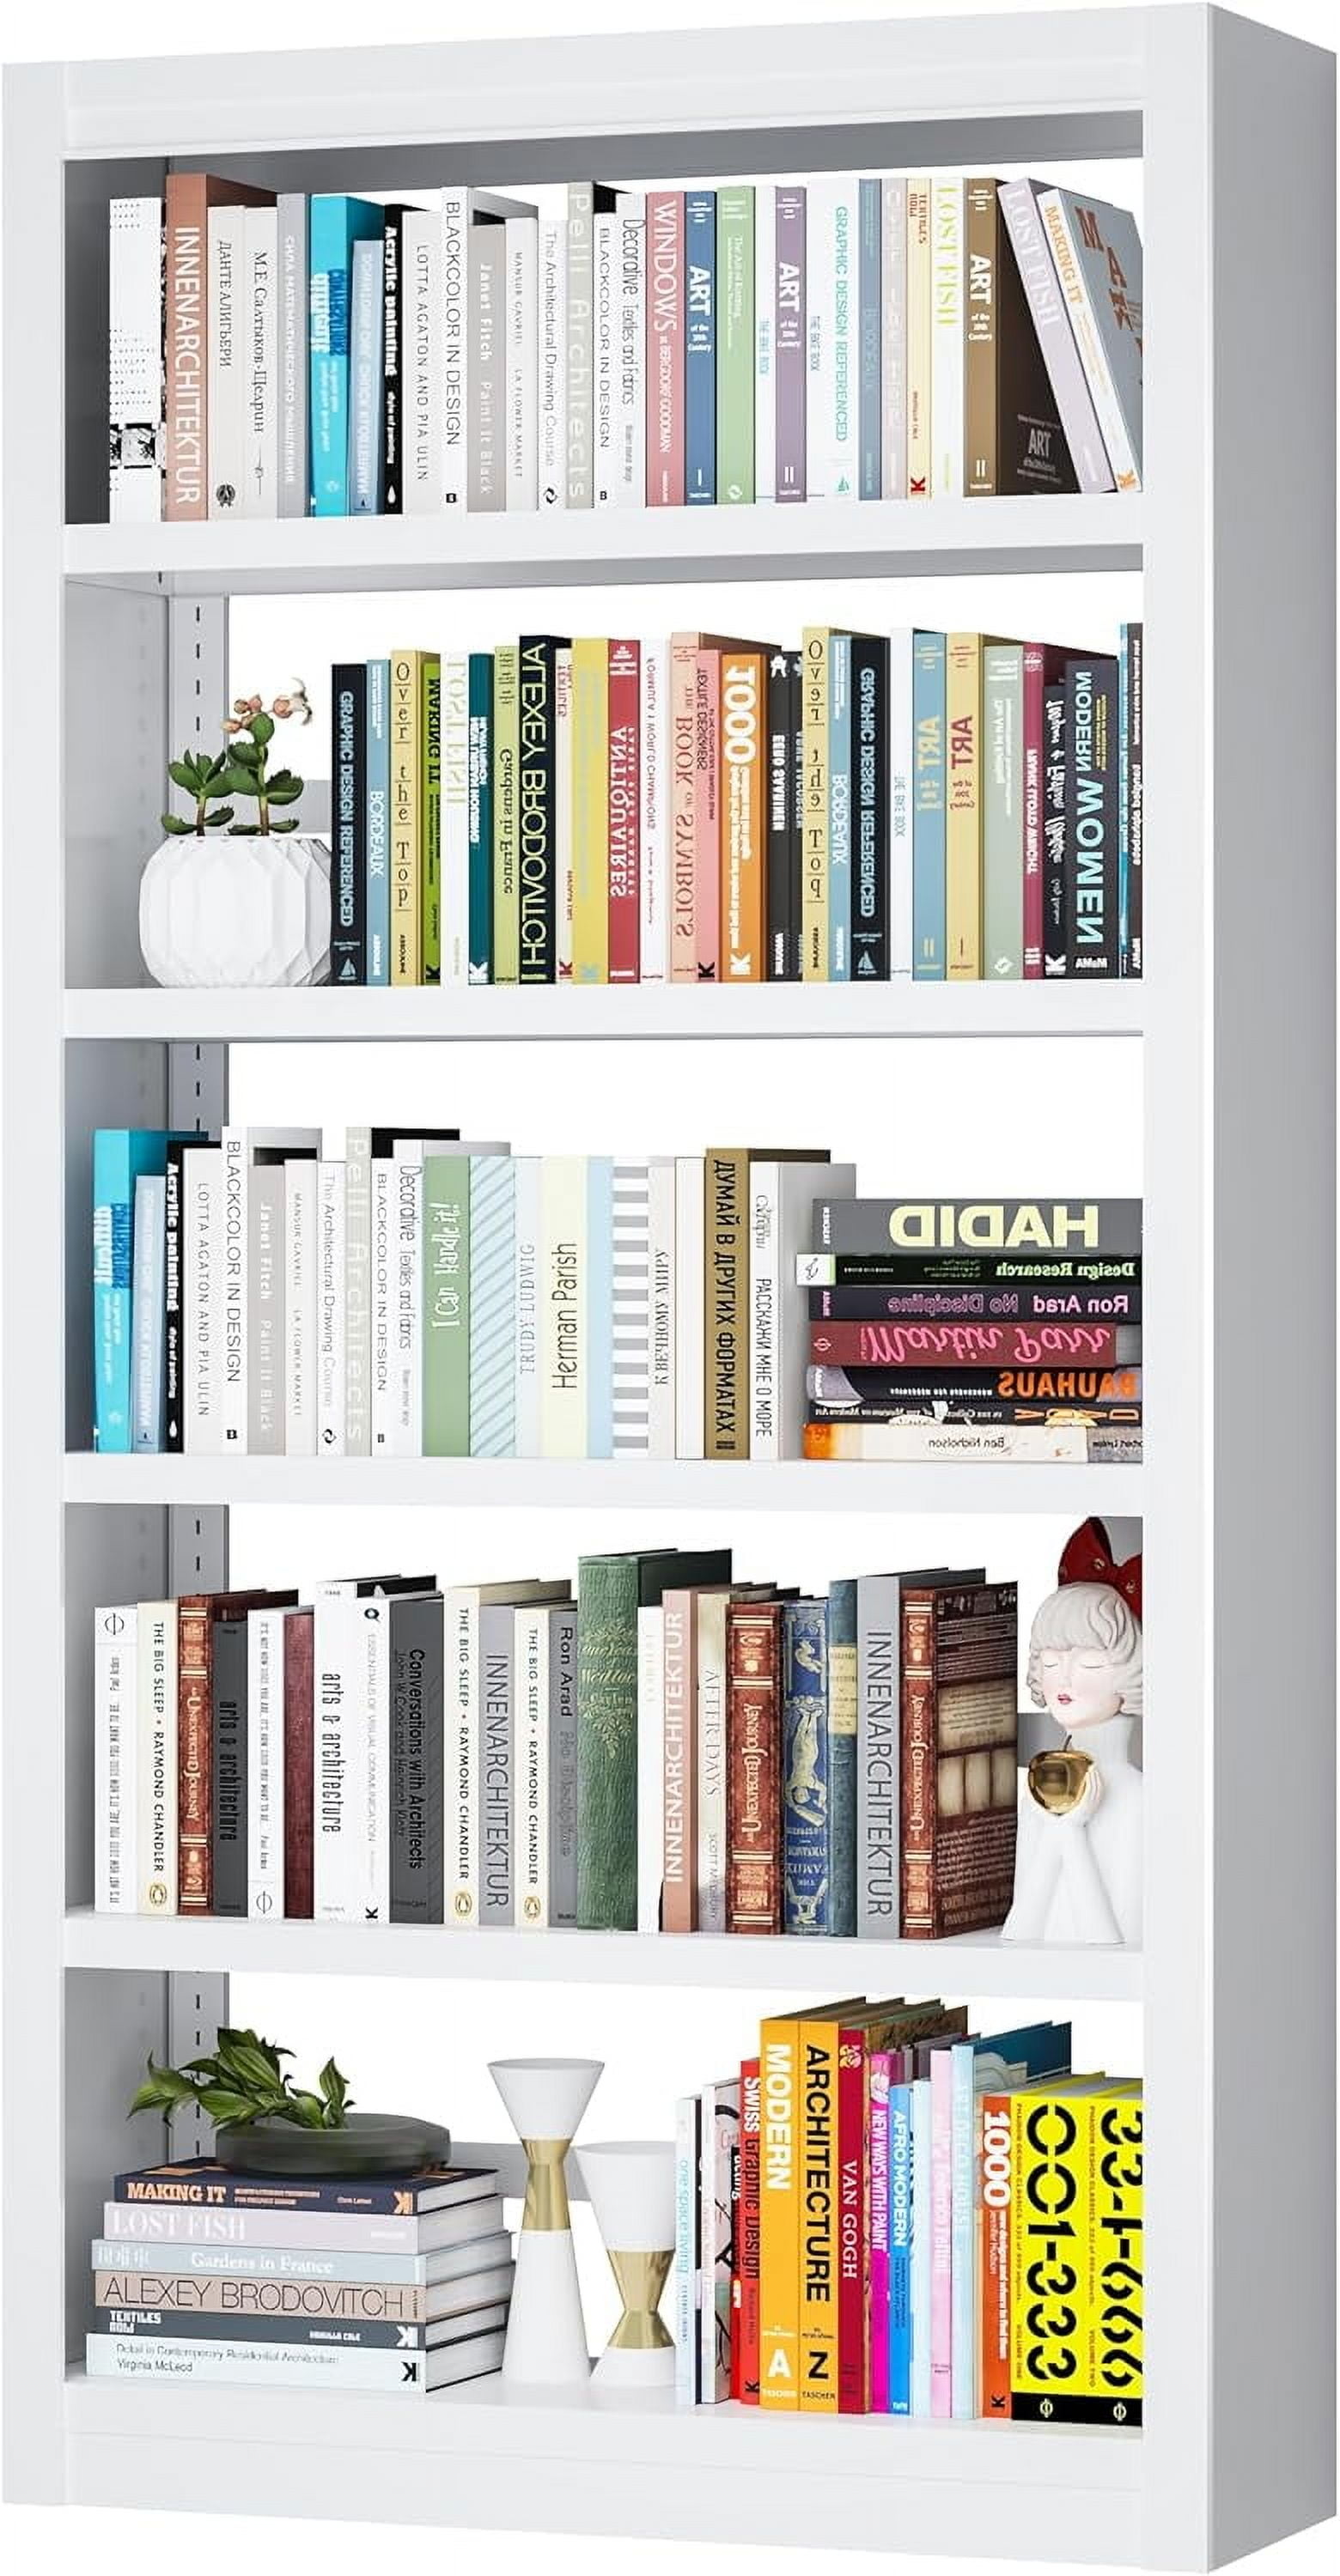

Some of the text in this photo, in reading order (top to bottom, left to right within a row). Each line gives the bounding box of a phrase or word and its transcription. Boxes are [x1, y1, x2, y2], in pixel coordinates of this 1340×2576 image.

[384, 226, 398, 376] Acrylic painting
[446, 202, 460, 445] BLACKCOLOR IN DESIGN
[542, 261, 557, 411] Architectural Drawing
[599, 228, 611, 448] BLACKCOLOR IN DESIGN
[622, 219, 645, 364] Decorative and
[653, 200, 678, 331] WINDOWS
[689, 265, 711, 316] ART
[779, 262, 800, 312] ART
[835, 207, 848, 441] GRAPHIC DESIGN REFERENCED
[969, 255, 991, 304] ART
[174, 226, 200, 503] INNENARCHITEKTUR
[417, 245, 429, 481] LOTTA AGATON AND PIA ULIN
[339, 691, 353, 927] GRAPHIC DESIGN REFERENCED
[369, 790, 385, 878] BORDEAUX
[167, 1163, 179, 1312] Acrylic painting
[198, 1182, 210, 1416] LOTTA AGATON AND PIA ULIN
[226, 1141, 241, 1382] BLACKCOLOR IN DESIGN
[321, 1205, 336, 1352] Architectural Drawing
[377, 1173, 387, 1391] BLACKCOLOR IN DESIGN
[399, 1165, 423, 1309] Decorative and
[431, 1227, 460, 1328] I Can Handle
[521, 1245, 535, 1375] TRUDY LUDWIG
[655, 1249, 669, 1371] ВЕЧНОМУ МИРУ
[714, 1160, 740, 1432] ДУМАЙ В ДРУГИХ ФОРМАТАХ
[551, 1242, 577, 1389] Herman Parish
[755, 1279, 772, 1437] РАССКАЖИ МНЕ МОРЕ
[459, 1608, 469, 1880] THE BIG SLEEP RAYMOND CHANDLER
[560, 1626, 573, 1717] Ron Arad
[704, 1669, 722, 1796] AFTER DAYS
[153, 1622, 164, 1872] THE BIG SLEEP RAYMOND CHANDLER
[219, 1701, 241, 1841] arts architecture
[322, 1674, 346, 1832] arts architecture
[409, 1649, 426, 1869] Conversations with Architects
[486, 1655, 509, 1907] INNENARCHITEKTUR
[528, 1628, 538, 1885] THE BIG SLEEP RAYMOND CHANDLER
[665, 1613, 685, 1883] INNENARCHITEKTUR
[866, 1631, 892, 1916] INNENARCHITEKTUR
[766, 2044, 792, 2190] MODERN
[806, 2044, 831, 2301] ARCHITECTURE
[872, 2109, 888, 2252] NEW WAYS WITH PAINT
[893, 2110, 907, 2151] AFRO
[984, 2111, 1011, 2207] 1000
[112, 2209, 247, 2240] LOST FISH
[127, 2183, 204, 2202] MAKING
[205, 2186, 227, 2203] IT
[192, 2251, 334, 2275] Gardens in France
[676, 2160, 691, 2274] one space living
[744, 2138, 760, 2279] Graphic Design
[842, 2160, 858, 2279] VAN GOGH
[893, 2154, 907, 2246] MODERN
[102, 2276, 404, 2318] ALEXEY BRODOVITCH
[155, 2360, 192, 2372] McLeod
